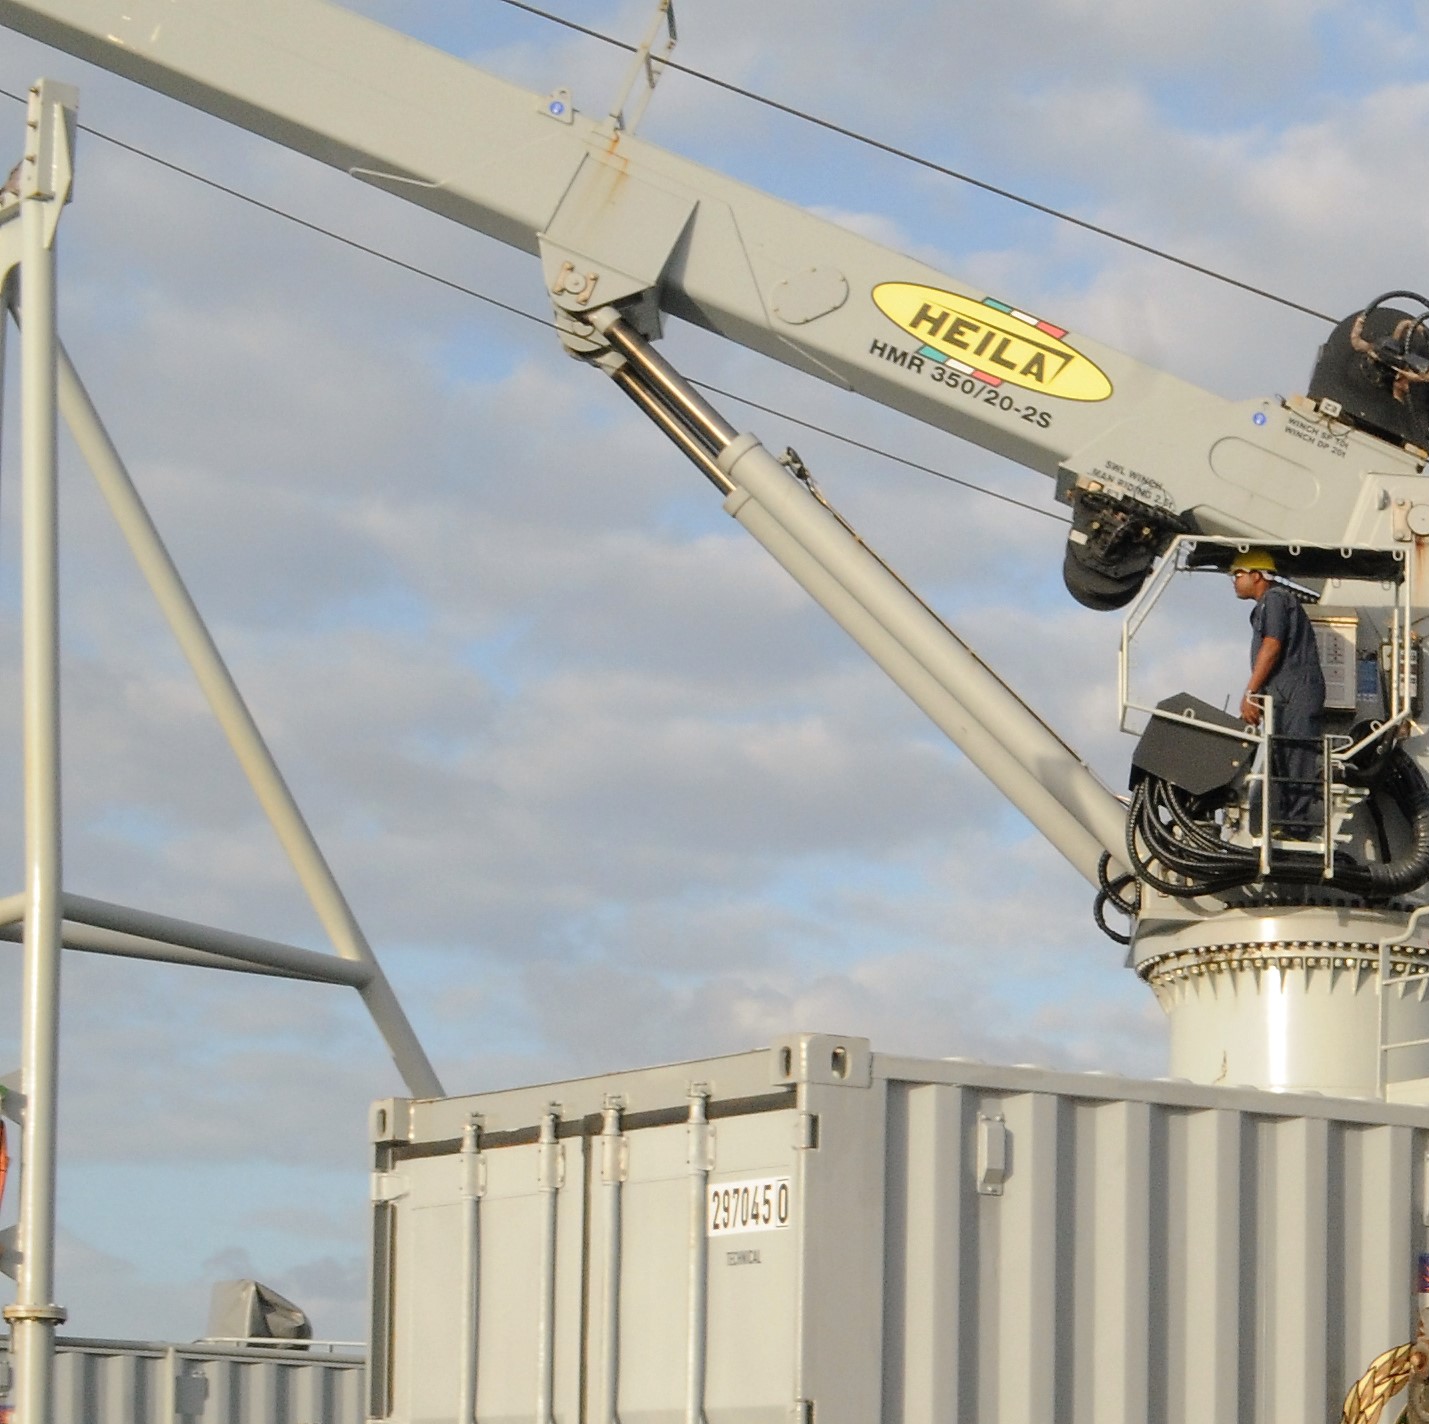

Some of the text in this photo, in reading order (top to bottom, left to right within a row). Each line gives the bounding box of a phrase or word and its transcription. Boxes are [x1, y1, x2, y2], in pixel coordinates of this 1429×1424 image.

[908, 302, 1048, 385] HEILA
[869, 338, 1054, 429] HMR 350/20-2S
[1284, 426, 1315, 445] WINCH
[1288, 417, 1319, 436] WINCH
[1128, 469, 1164, 490] WINCH
